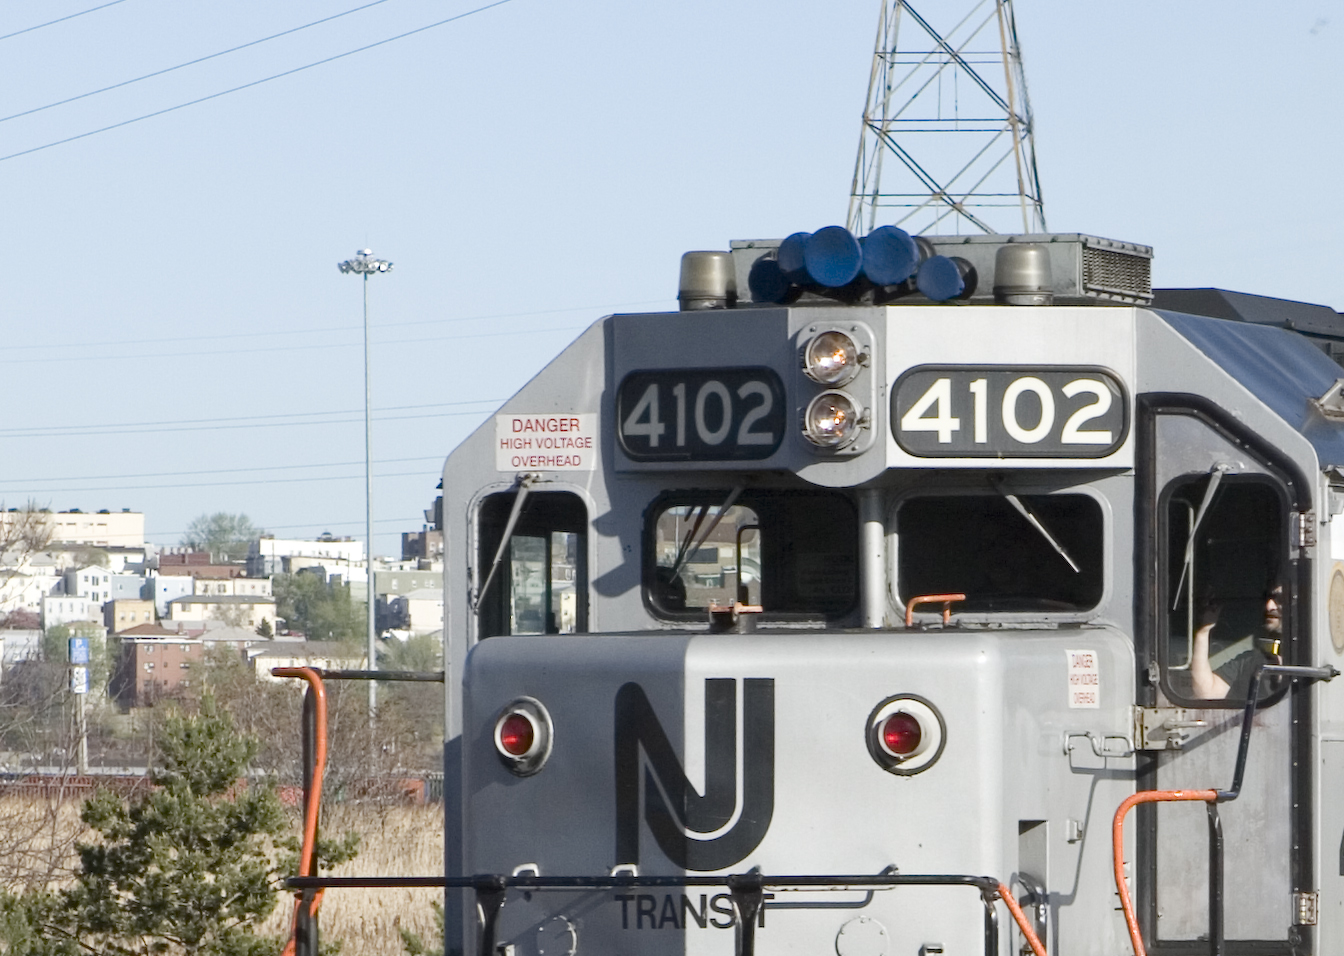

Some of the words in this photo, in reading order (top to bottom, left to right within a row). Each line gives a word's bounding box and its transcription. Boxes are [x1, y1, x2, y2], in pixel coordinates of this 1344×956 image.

[623, 380, 774, 447] 4102
[901, 376, 1112, 444] 4102
[512, 418, 580, 433] DANGER
[500, 437, 532, 449] HIGH
[536, 436, 593, 449] VOLTAGE
[511, 455, 582, 468] OVERHEAD
[1072, 654, 1093, 669] DANGER
[1073, 692, 1095, 704] OVERHEAD
[614, 677, 776, 872] NJ
[614, 893, 775, 930] TRANST
